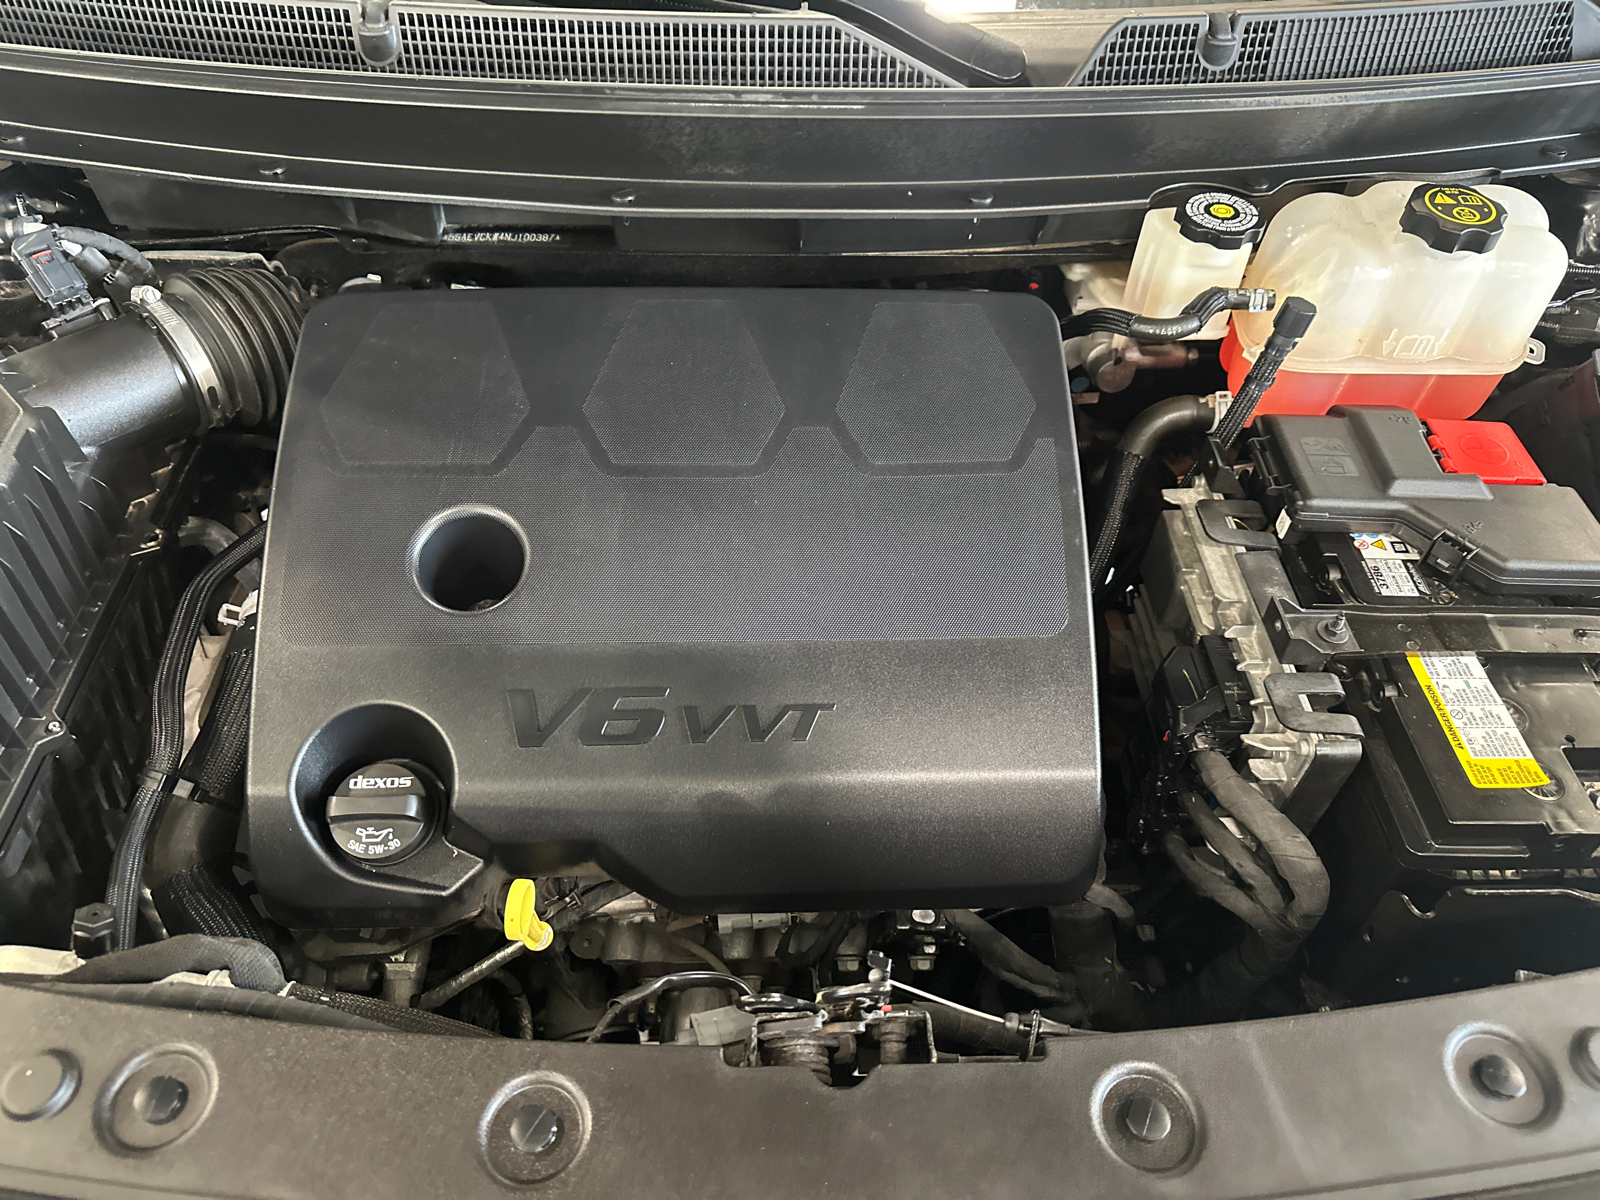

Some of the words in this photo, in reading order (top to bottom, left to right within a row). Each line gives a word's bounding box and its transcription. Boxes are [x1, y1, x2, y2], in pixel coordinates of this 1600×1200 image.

[1370, 566, 1389, 590] 3786
[506, 688, 671, 748] V6
[682, 703, 837, 744] VVT
[1424, 684, 1461, 744] DANGER/POISON
[348, 774, 415, 790] dexos
[347, 839, 367, 854] SAE
[367, 838, 402, 855] 5W-30
